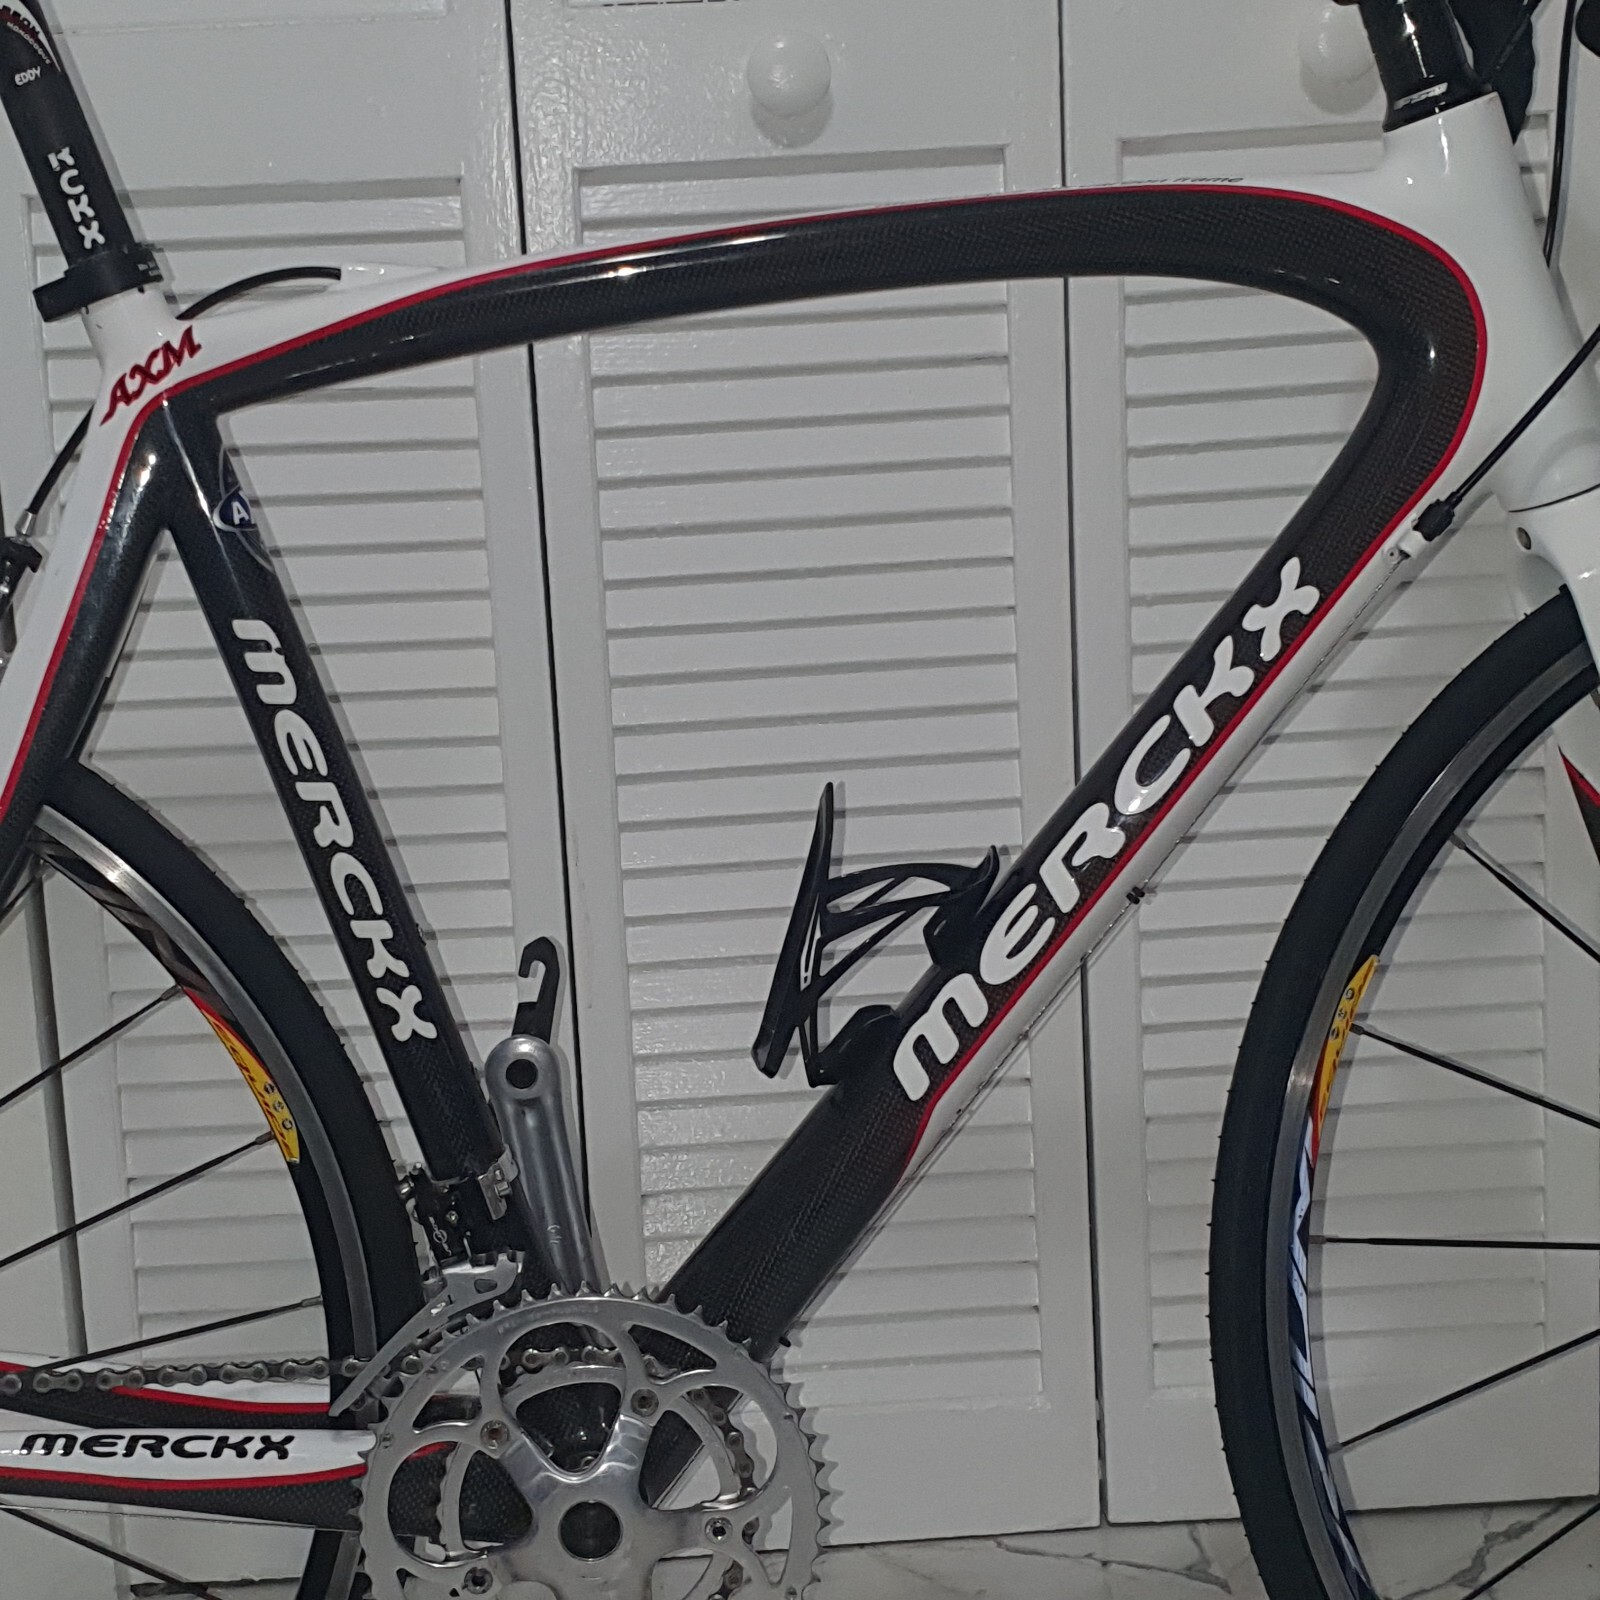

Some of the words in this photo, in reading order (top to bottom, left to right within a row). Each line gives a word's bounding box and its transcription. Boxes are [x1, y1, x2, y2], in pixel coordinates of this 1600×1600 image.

[14, 66, 41, 86] EDDY
[99, 325, 202, 426] AXM
[231, 618, 438, 1042] MERCKX
[893, 556, 1320, 1101] MERCKX
[20, 1433, 295, 1460] MERCKX
